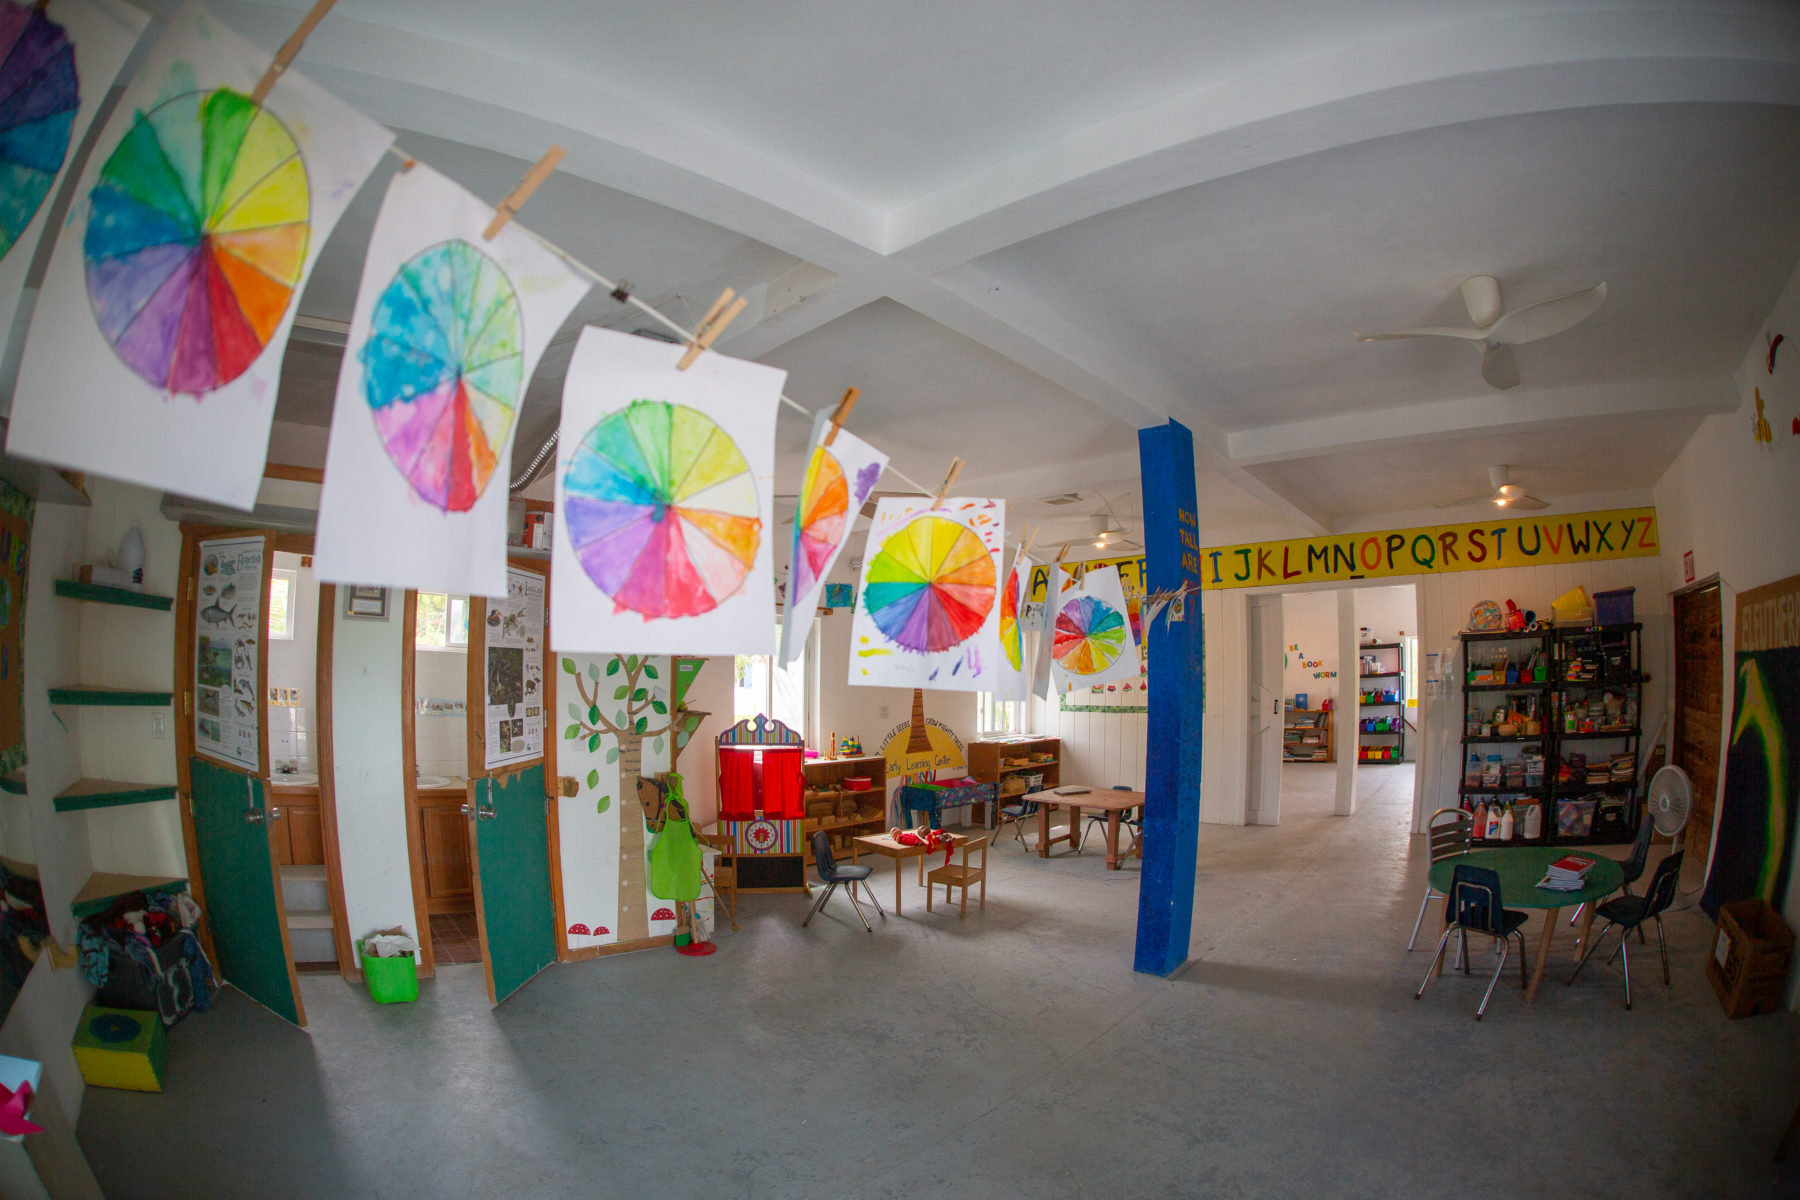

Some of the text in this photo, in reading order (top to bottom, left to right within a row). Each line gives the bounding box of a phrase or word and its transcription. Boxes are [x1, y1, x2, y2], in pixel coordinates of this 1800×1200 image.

[1178, 507, 1196, 528] HOW
[1179, 529, 1198, 550] TALL
[1181, 552, 1198, 574] ARE
[1289, 644, 1299, 652] BE
[1302, 660, 1323, 668] BOOK
[1313, 671, 1337, 679] WORM
[880, 729, 897, 751] LITTLE
[897, 720, 911, 733] SEEDS
[906, 758, 931, 771] Learning
